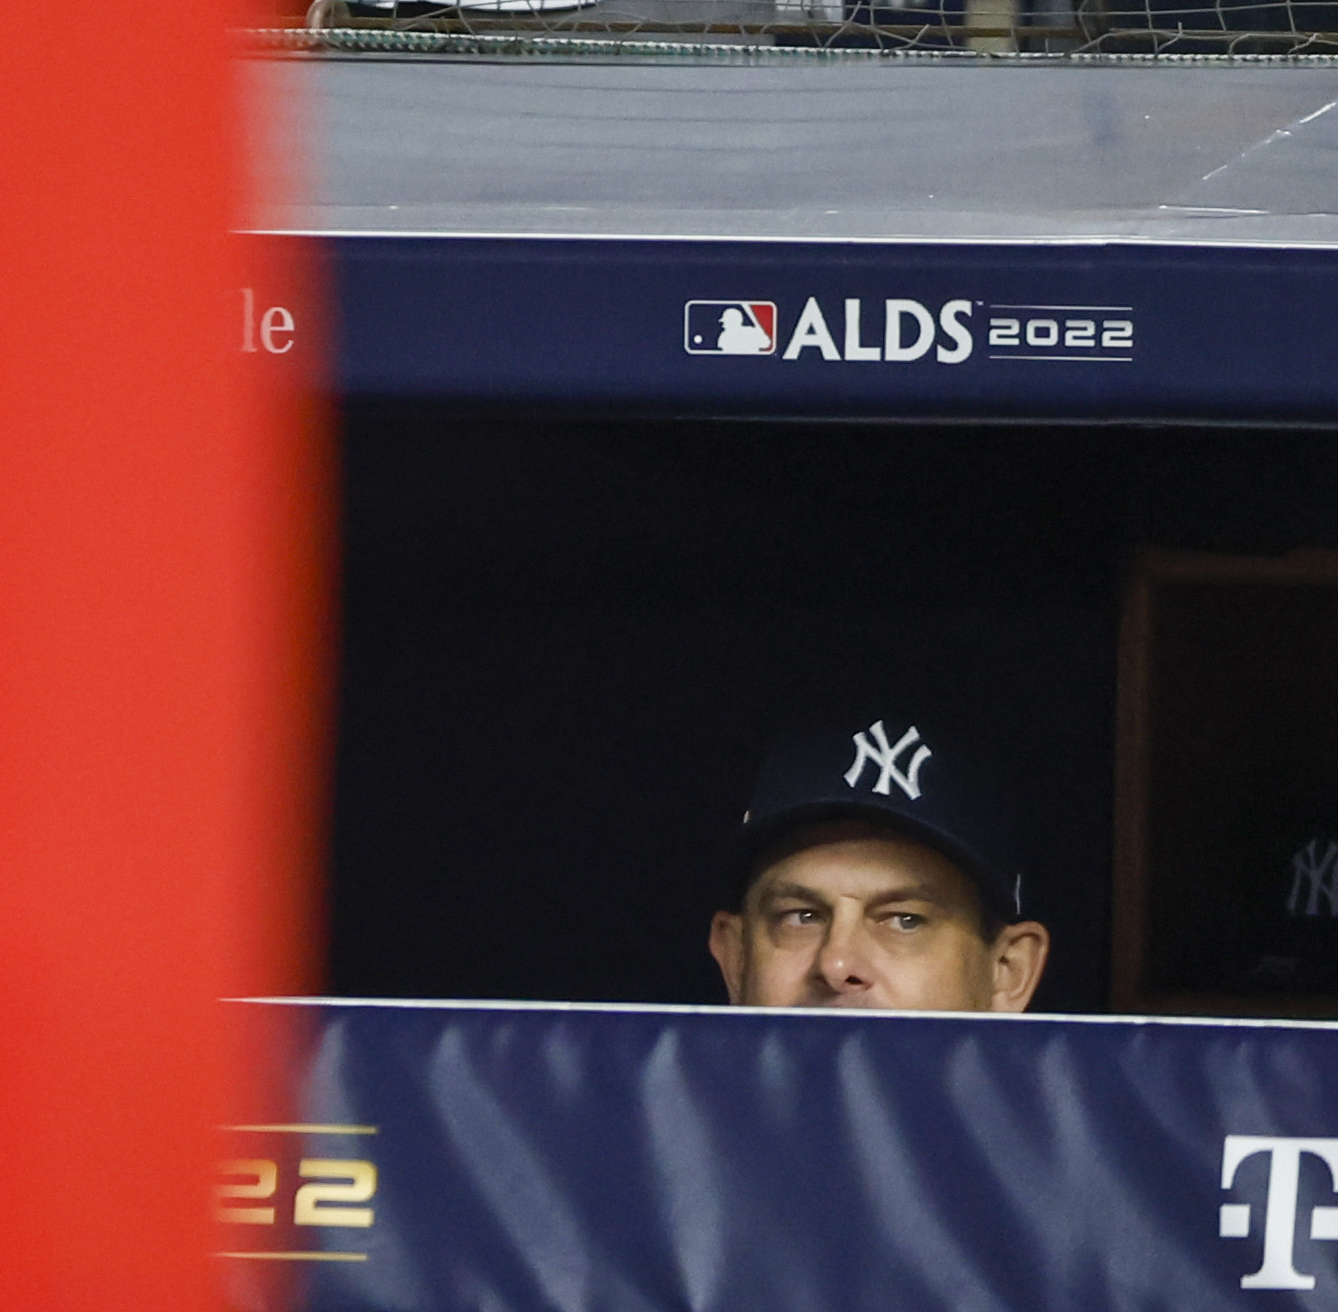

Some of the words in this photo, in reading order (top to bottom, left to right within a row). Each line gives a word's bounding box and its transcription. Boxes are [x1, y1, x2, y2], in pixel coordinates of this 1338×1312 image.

[782, 298, 974, 364] ALDS
[988, 317, 1134, 348] 2022
[842, 719, 933, 801] NY
